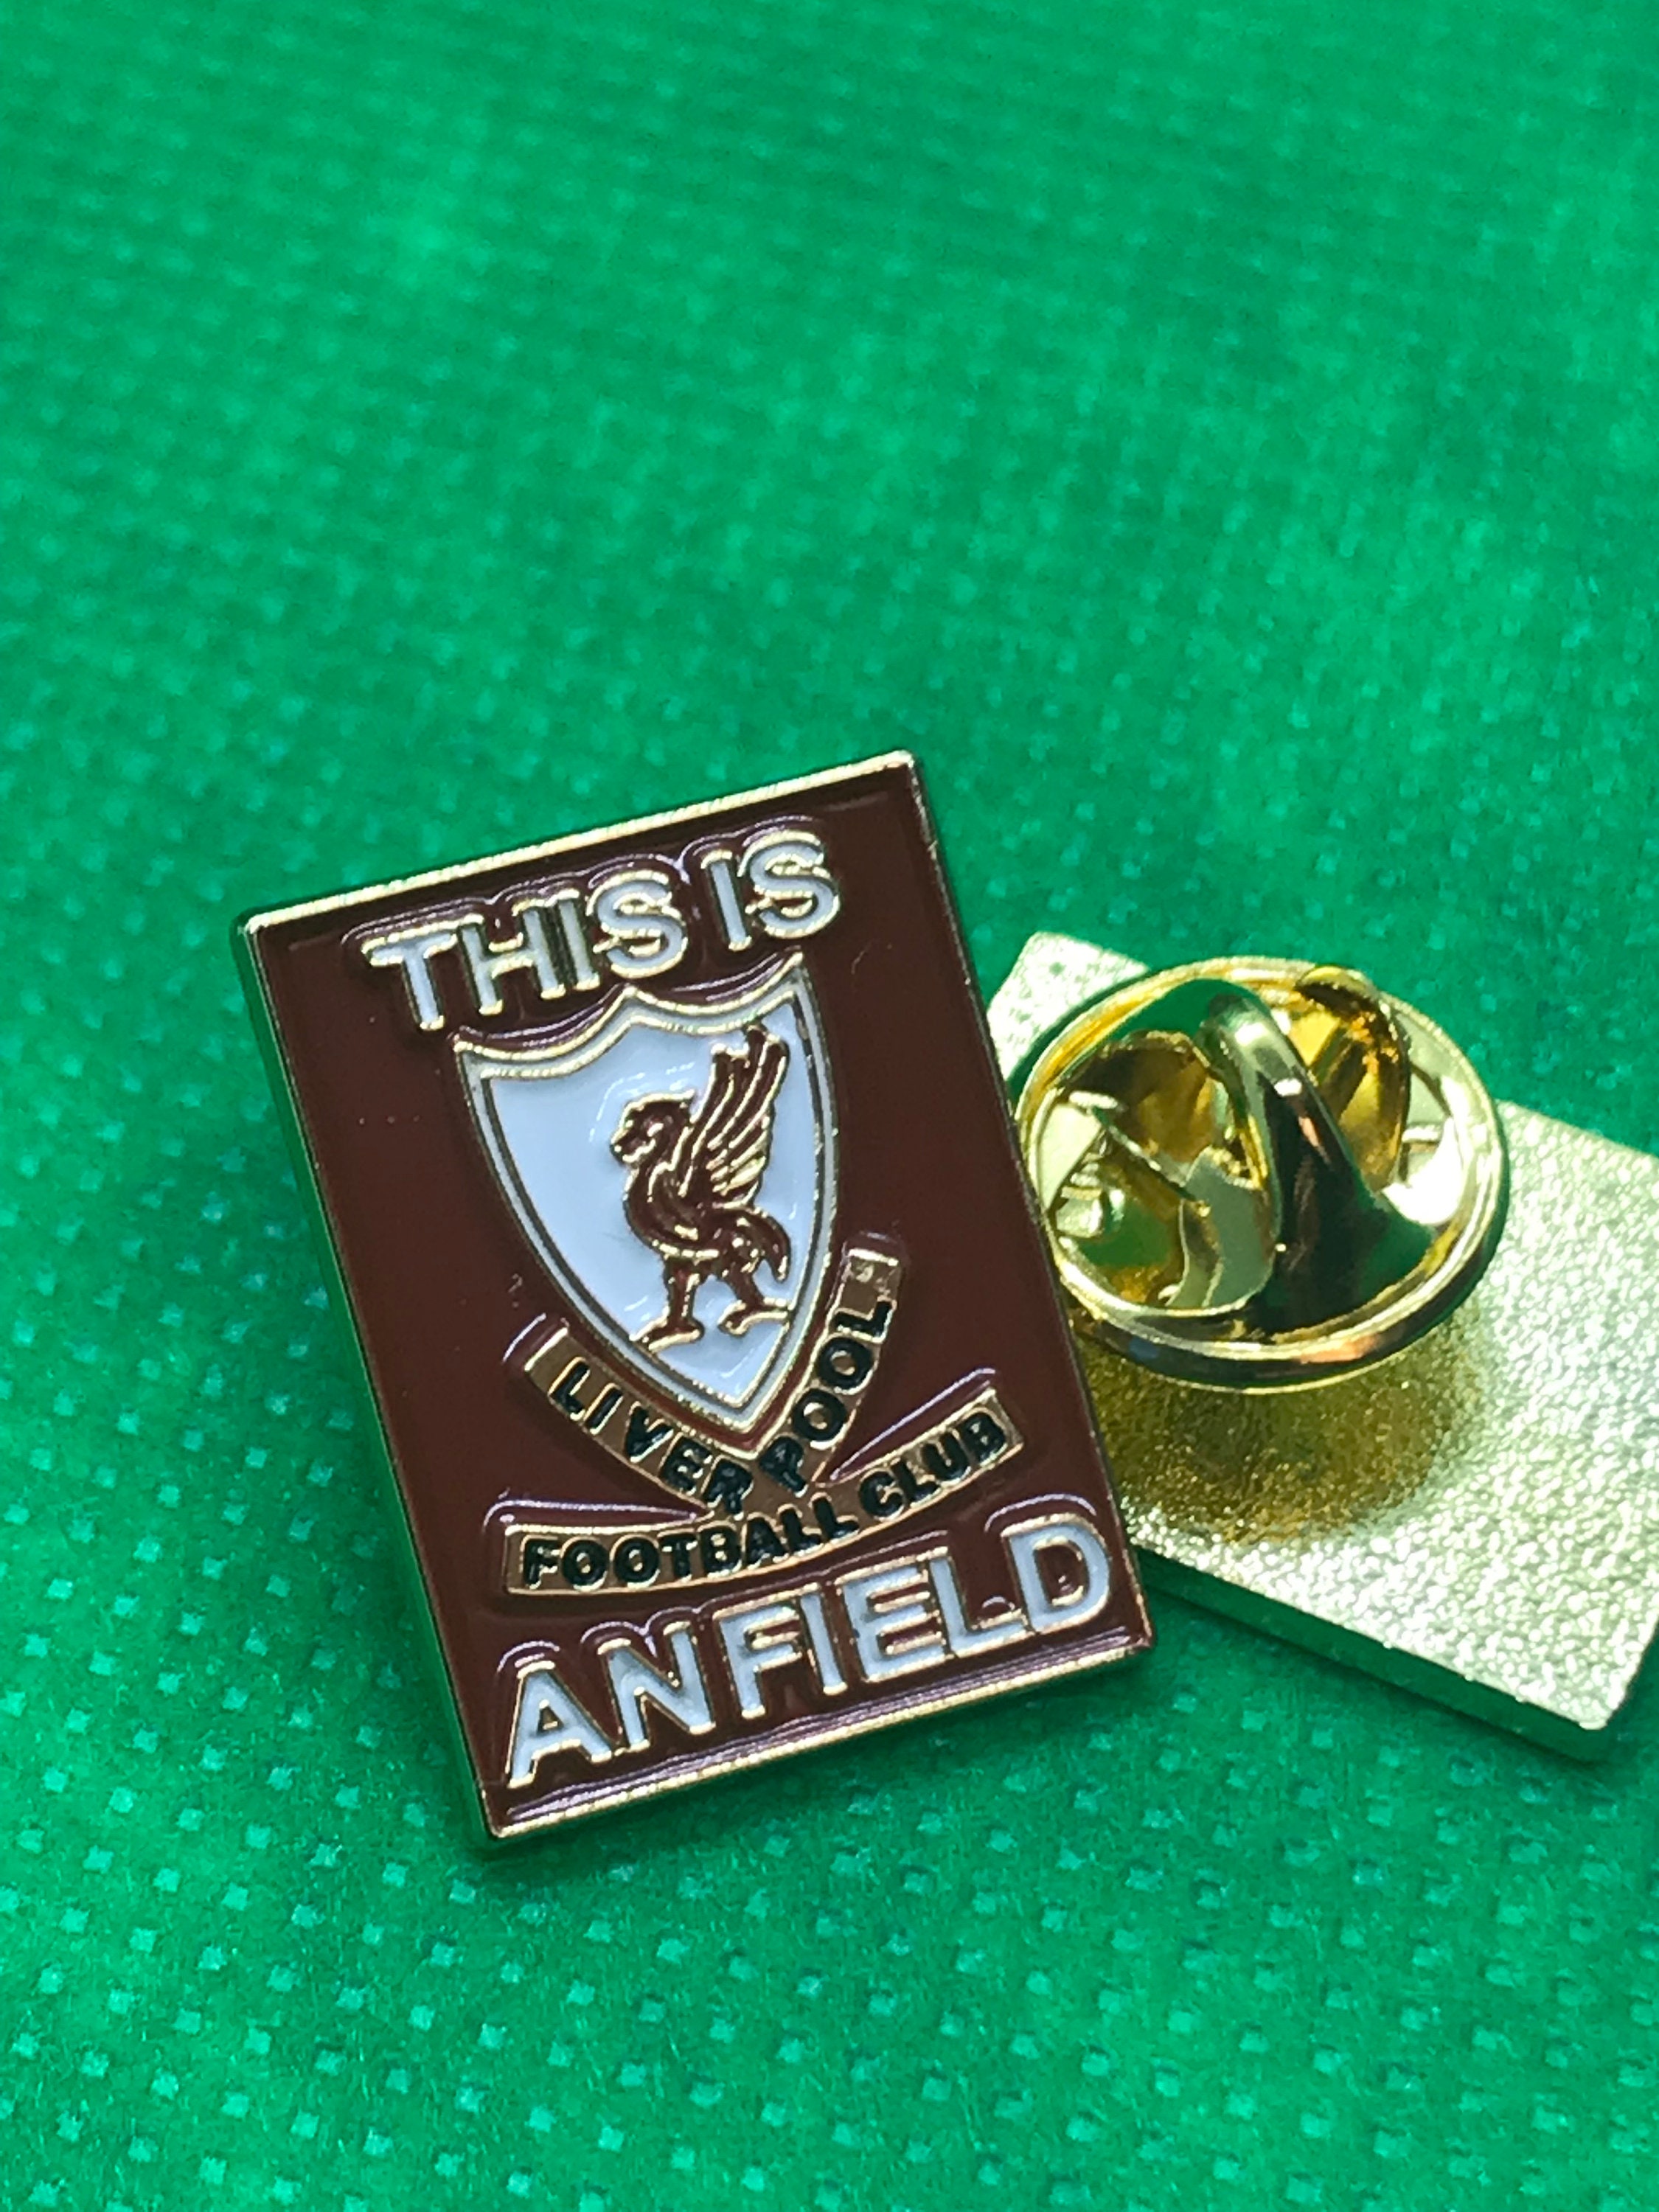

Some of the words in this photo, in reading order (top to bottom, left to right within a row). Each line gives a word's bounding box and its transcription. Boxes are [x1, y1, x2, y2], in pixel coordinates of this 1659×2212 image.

[361, 870, 688, 1030] THIS
[701, 831, 840, 950] IS
[521, 1492, 860, 1591] FOOTBALL
[858, 1408, 1007, 1520] CLUB
[549, 1299, 895, 1519] LIVERPOOL
[506, 1513, 1112, 1787] ANFIELD
